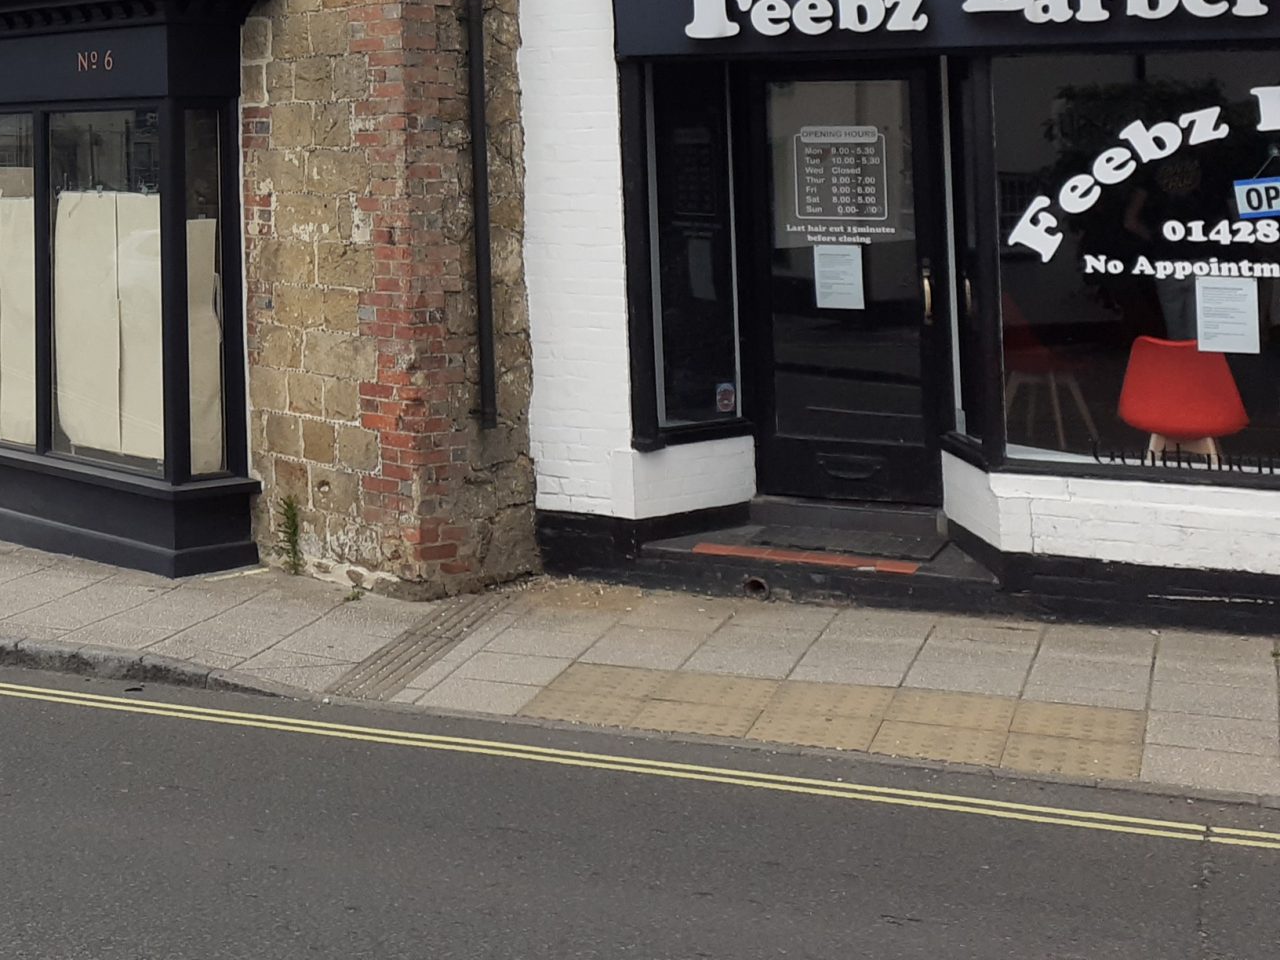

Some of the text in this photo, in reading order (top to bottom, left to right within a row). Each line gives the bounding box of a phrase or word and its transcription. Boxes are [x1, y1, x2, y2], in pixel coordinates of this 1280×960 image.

[104, 50, 113, 70] 6
[802, 130, 876, 138] OPENING HOURS
[805, 147, 823, 155] Mon
[805, 157, 821, 165] Tue
[805, 167, 861, 175] Wed Closed
[806, 176, 825, 184] Thur
[1008, 106, 1229, 263] Feebz
[806, 186, 817, 194] Fri
[806, 196, 820, 204] Sat
[806, 206, 823, 214] Sun
[807, 225, 827, 233] hair
[829, 225, 845, 233] cut
[1162, 220, 1280, 245] 01428
[838, 235, 872, 245] closing
[1084, 255, 1280, 280] No Appointm
